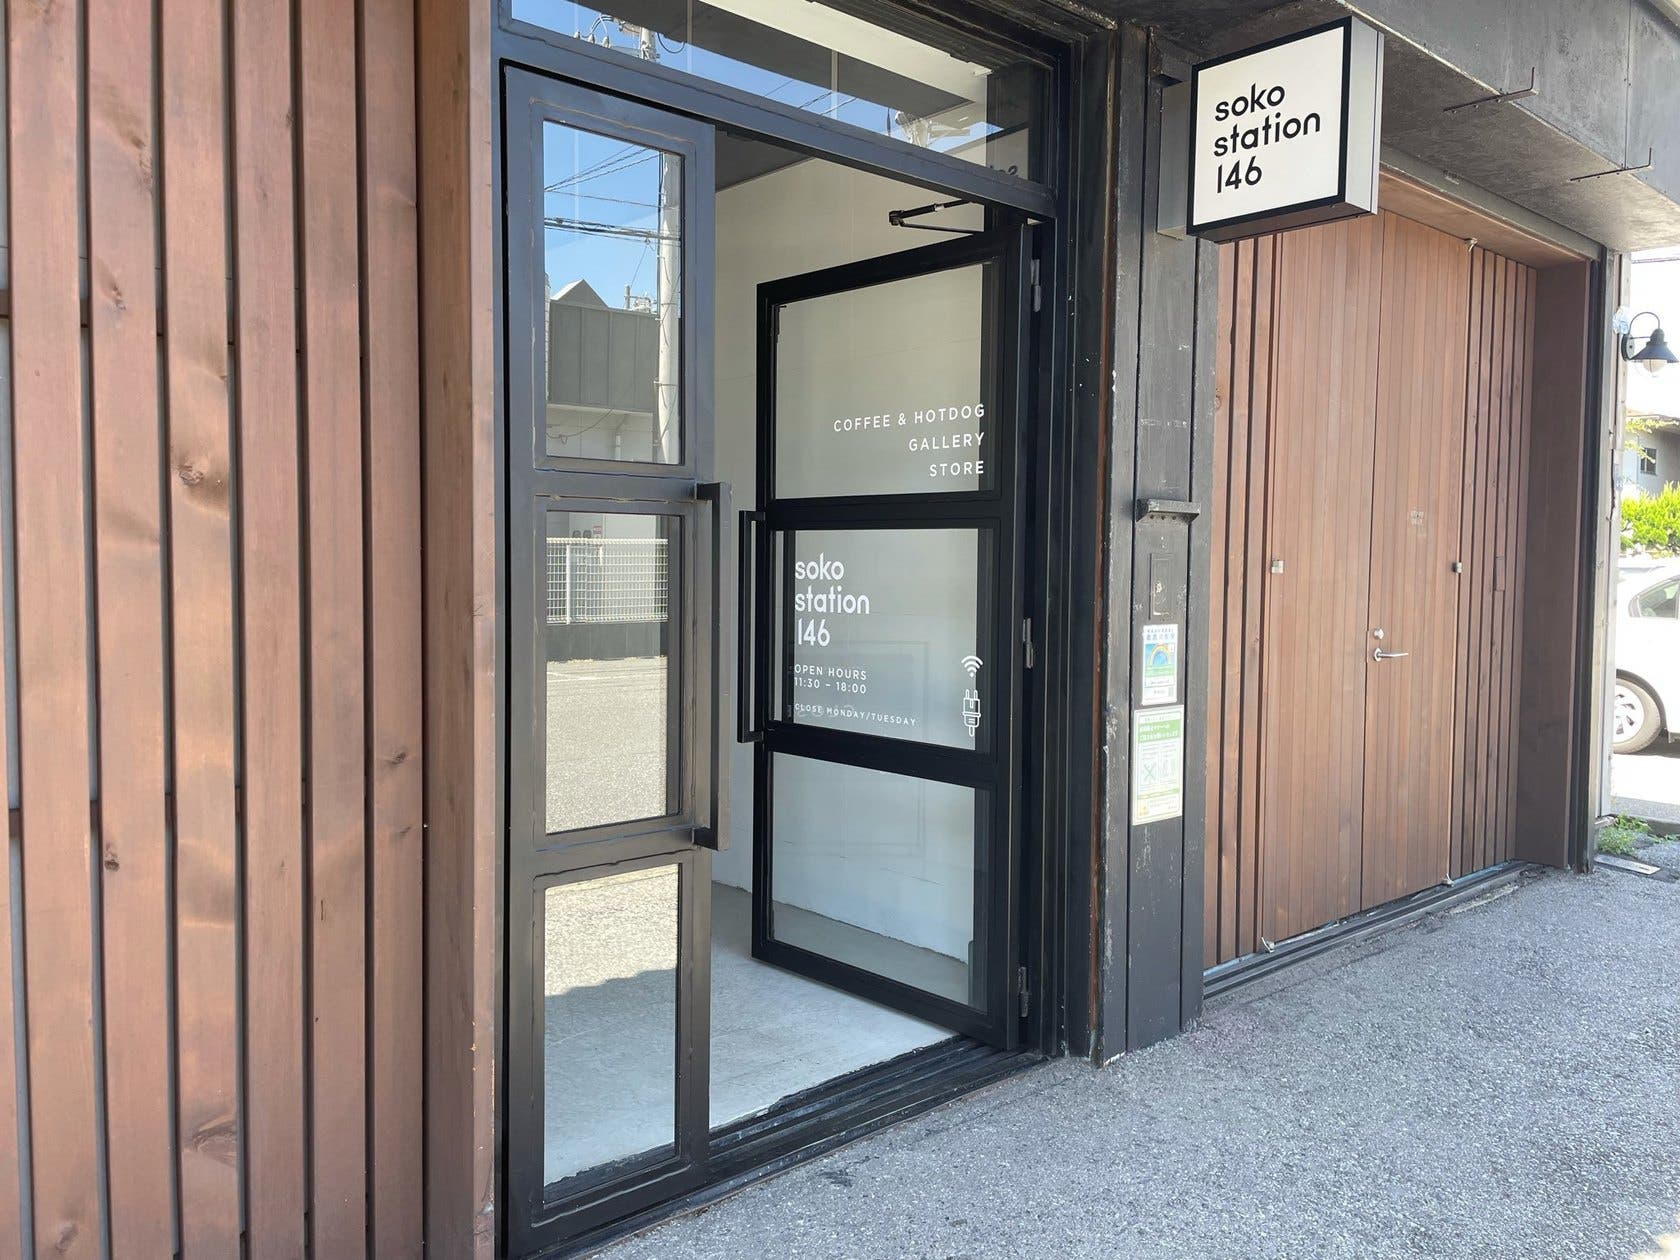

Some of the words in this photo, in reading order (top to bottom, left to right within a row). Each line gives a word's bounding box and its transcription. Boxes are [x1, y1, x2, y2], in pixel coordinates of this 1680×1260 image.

[1214, 83, 1285, 122] soko
[1214, 112, 1320, 157] station
[1216, 156, 1262, 194] 146
[833, 415, 891, 432] COFFEE
[898, 412, 906, 426] &
[914, 403, 985, 424] HOTDOG
[908, 432, 985, 452] GALLERY
[929, 460, 984, 477] STORE
[795, 552, 845, 580] soko
[795, 585, 870, 615] station
[798, 618, 831, 647] 146
[794, 677, 820, 689] 11:30
[836, 682, 867, 694] 18:00
[795, 664, 823, 676] OPEN
[828, 667, 867, 681] HOURS
[795, 703, 822, 713] CLOSE
[827, 706, 917, 726] MONDAY/TUESDAY
